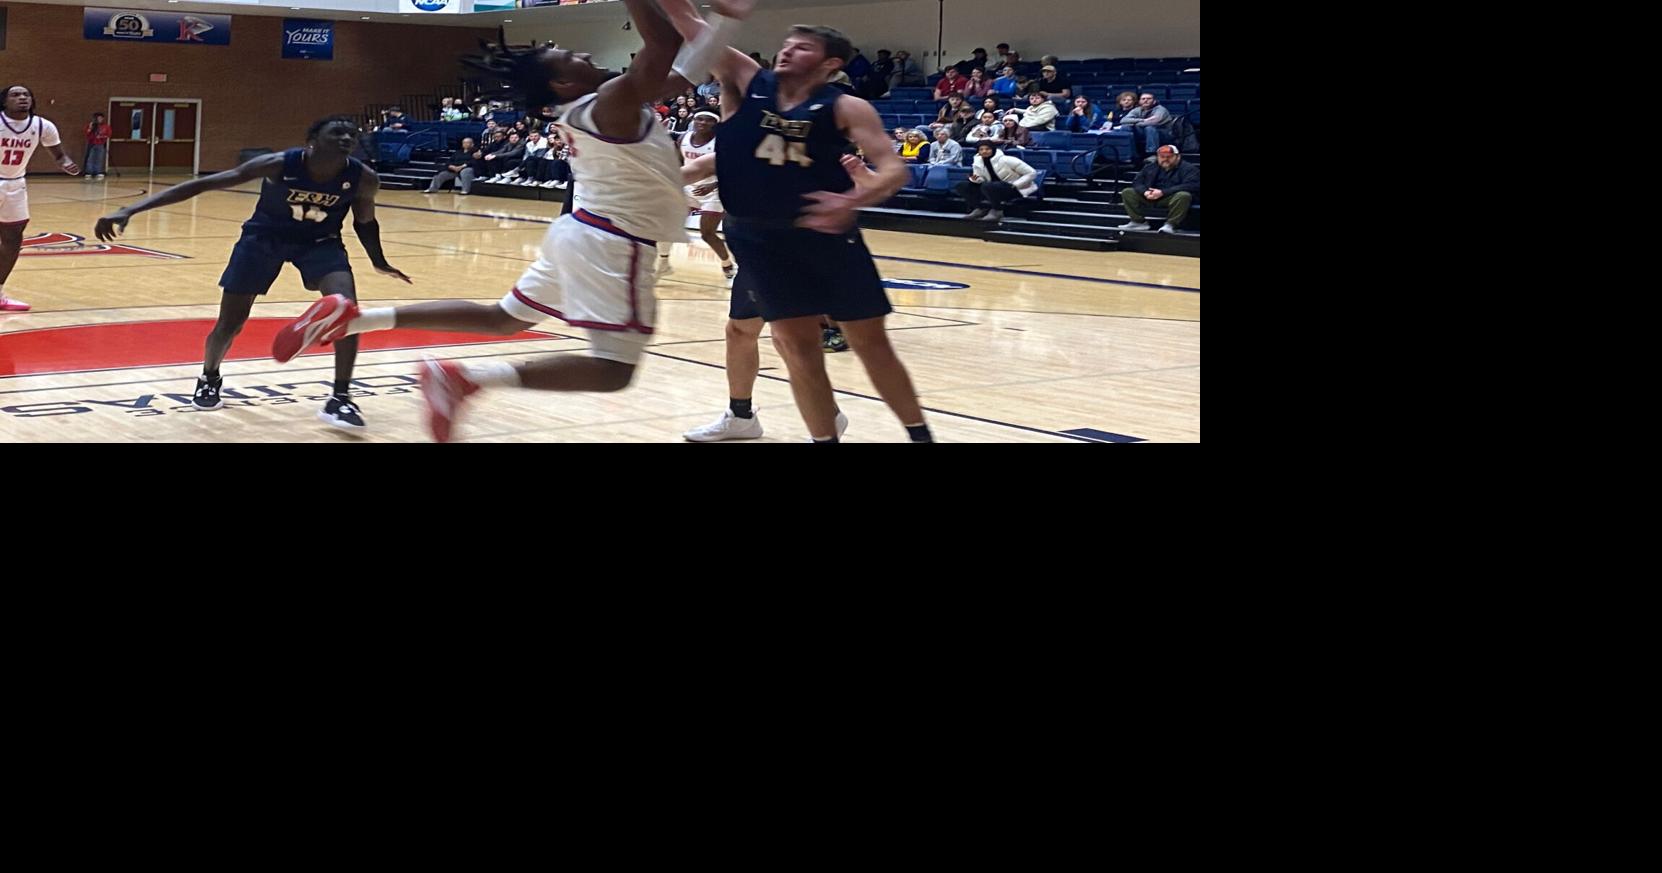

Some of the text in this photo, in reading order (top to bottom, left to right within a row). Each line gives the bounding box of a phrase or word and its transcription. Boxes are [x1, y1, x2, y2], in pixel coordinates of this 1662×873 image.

[119, 20, 140, 31] 50
[285, 28, 329, 45] YOURS
[1, 137, 32, 148] KING
[754, 133, 814, 168] 44
[1, 149, 25, 166] 13
